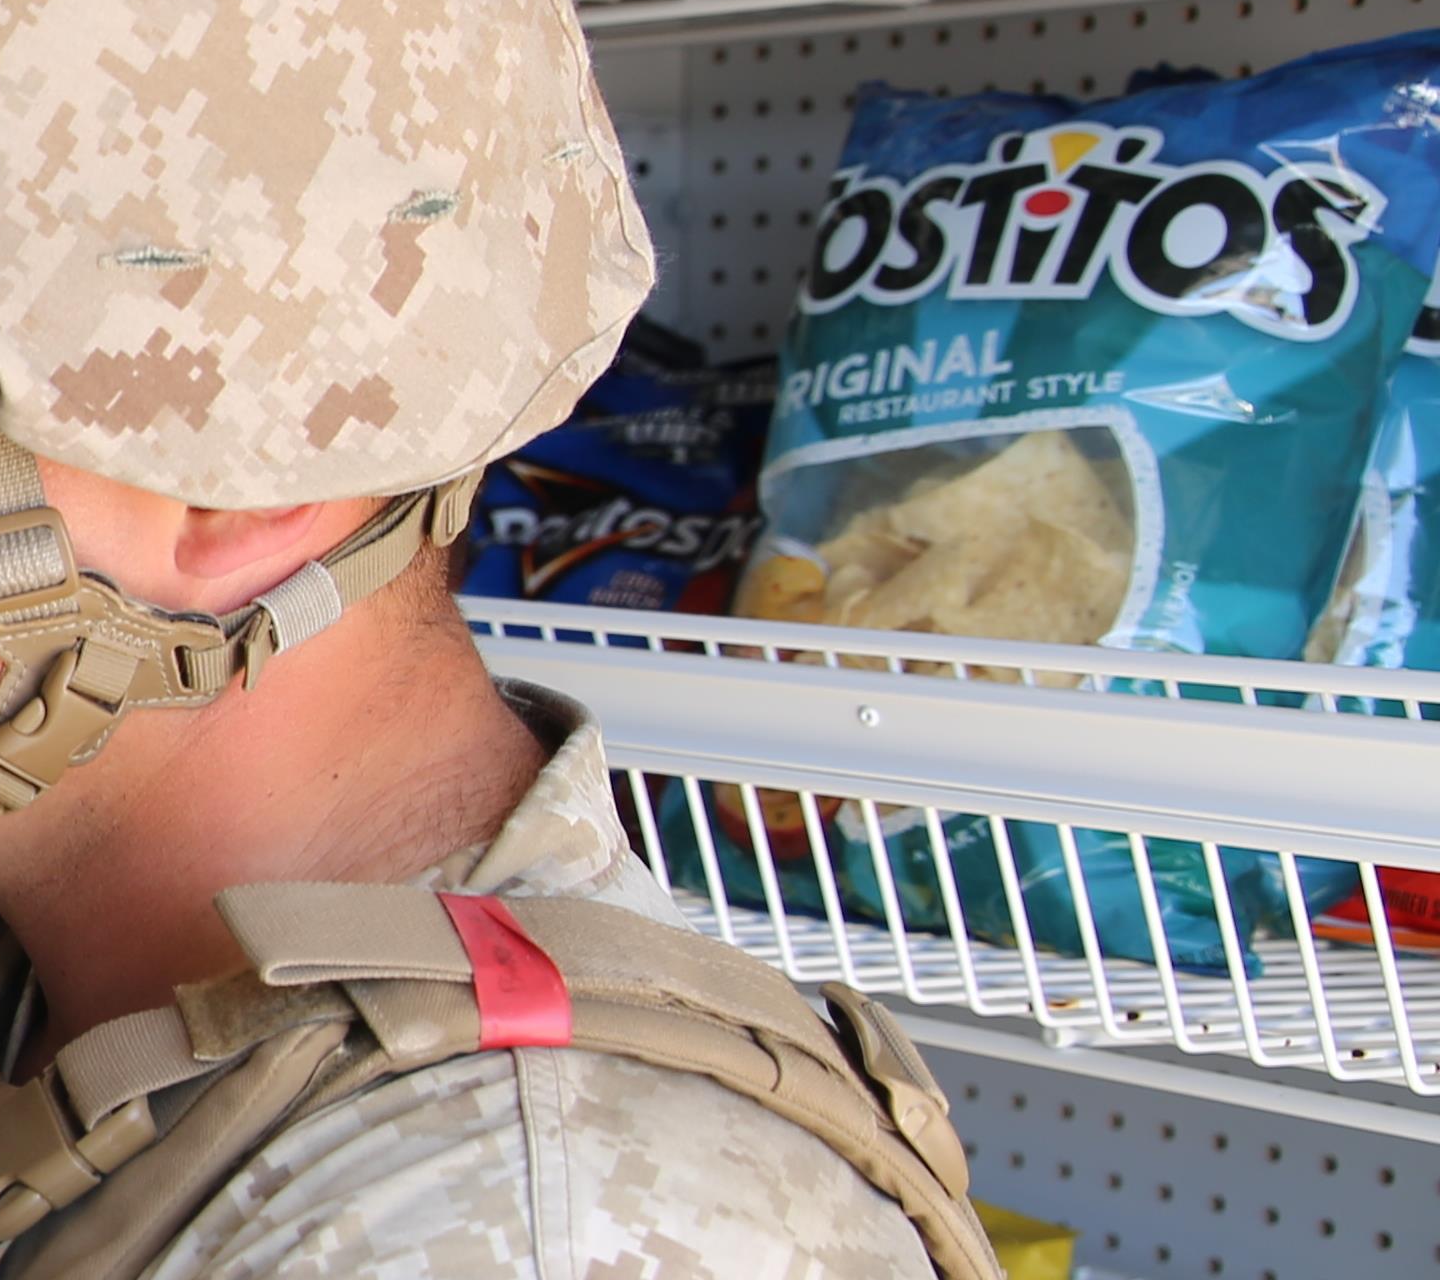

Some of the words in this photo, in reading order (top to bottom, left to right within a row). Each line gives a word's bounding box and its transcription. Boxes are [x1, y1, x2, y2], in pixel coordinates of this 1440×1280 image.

[810, 160, 1370, 327] OSTITOS
[784, 328, 1014, 417] RIGINAL
[837, 380, 1018, 426] RESTAURANT
[1026, 369, 1127, 401] STYLE
